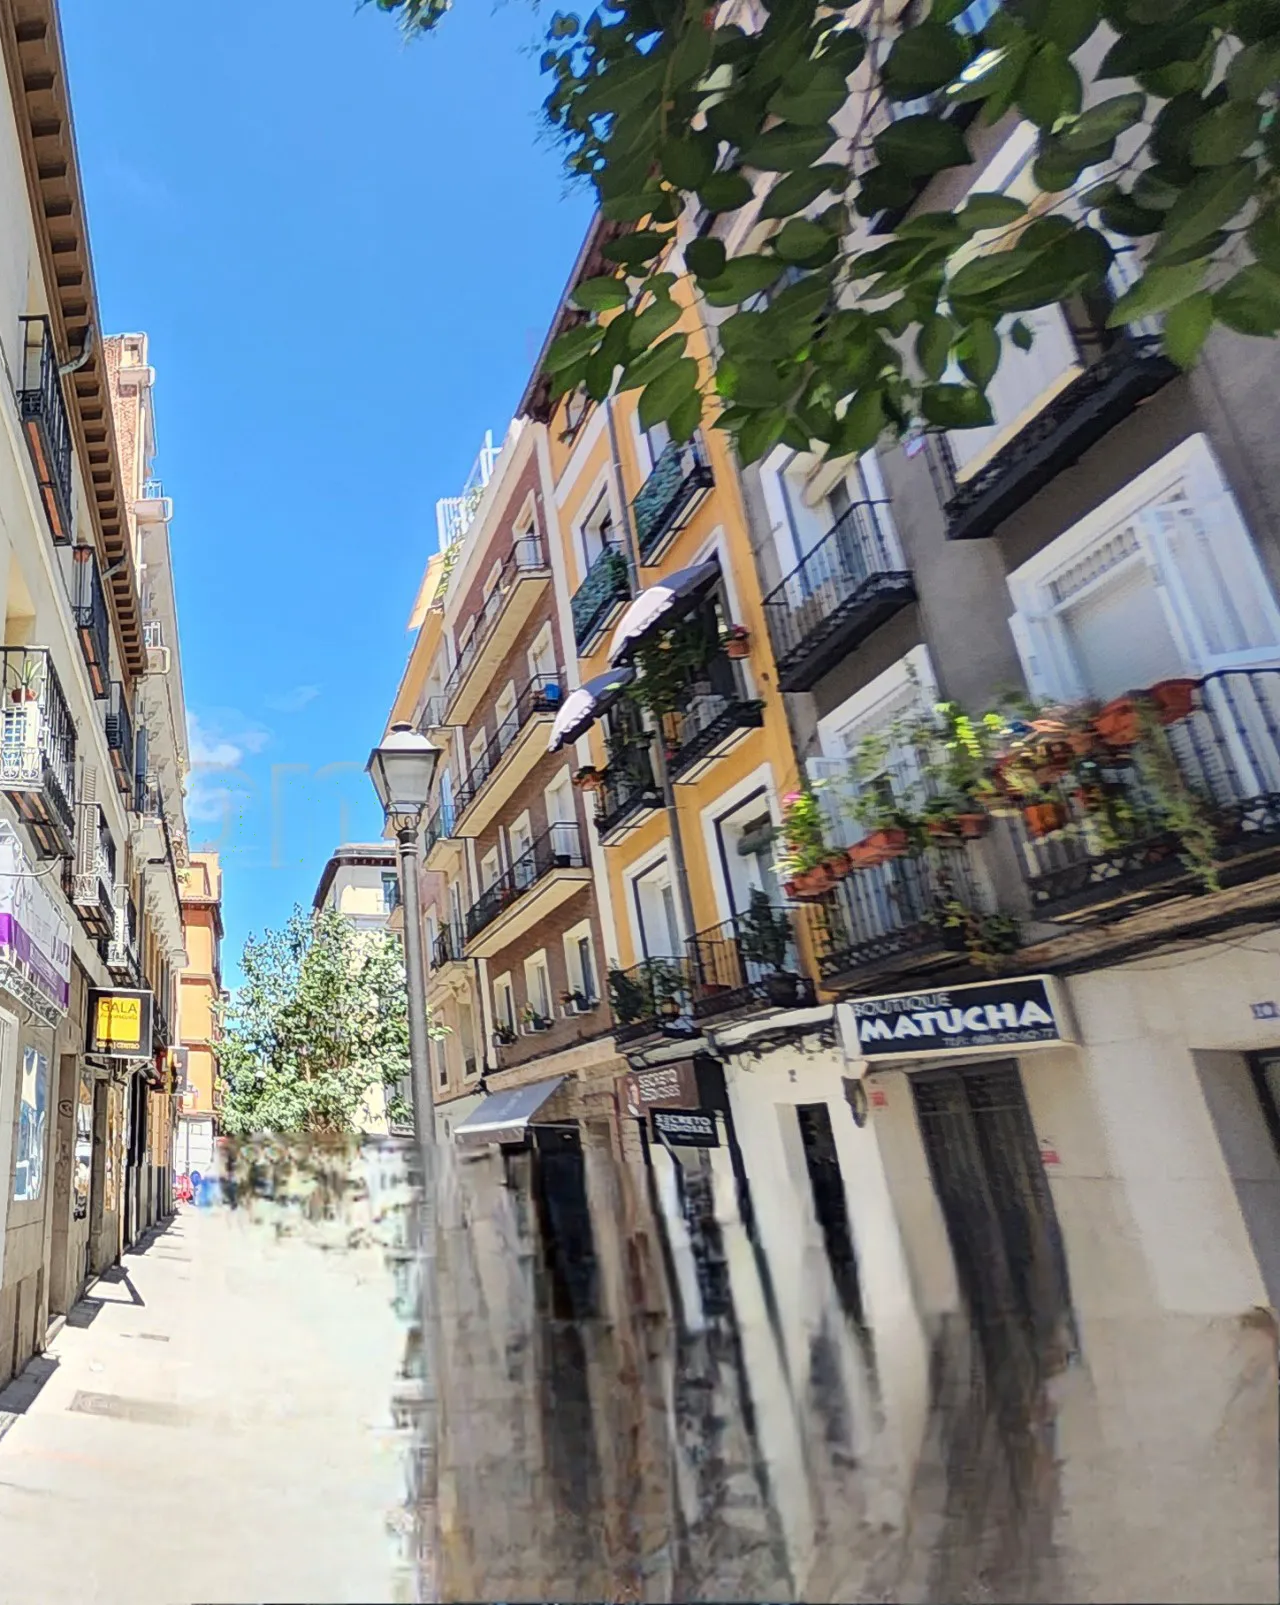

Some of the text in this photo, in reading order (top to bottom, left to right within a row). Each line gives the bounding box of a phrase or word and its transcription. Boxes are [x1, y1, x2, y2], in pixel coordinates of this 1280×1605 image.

[100, 1000, 138, 1015] GALA
[854, 992, 953, 1017] BOUTIQUE
[860, 1000, 1054, 1043] MATUCHA
